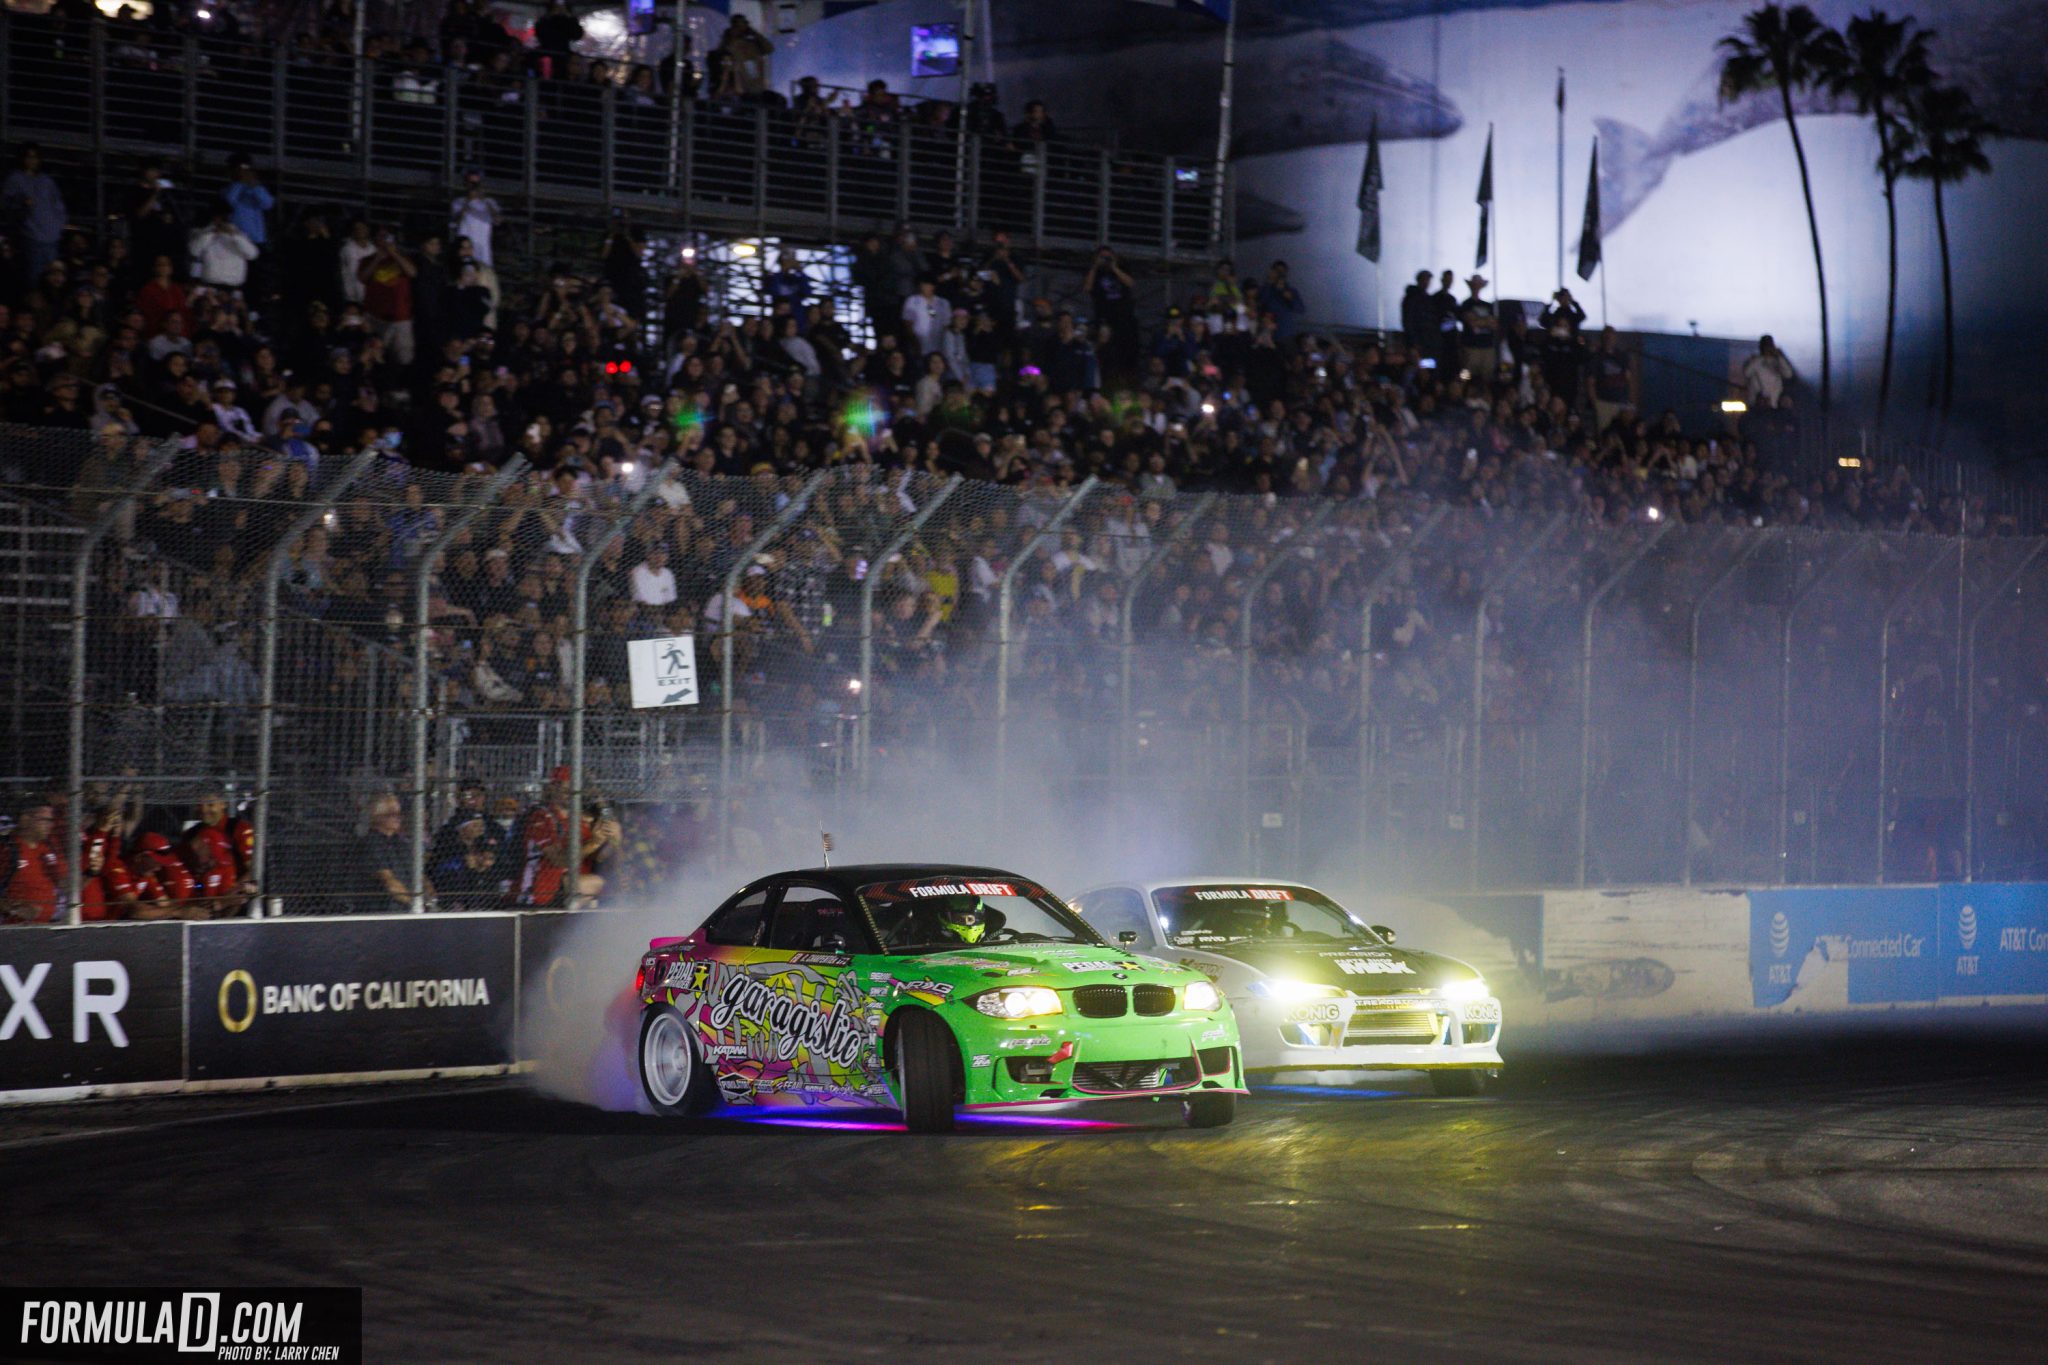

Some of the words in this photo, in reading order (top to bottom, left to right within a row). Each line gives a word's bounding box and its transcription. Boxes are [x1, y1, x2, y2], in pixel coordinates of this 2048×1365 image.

[658, 677, 692, 687] EXIT
[909, 884, 971, 898] FORMULA
[968, 883, 1015, 896] DRIFT
[1194, 890, 1251, 901] FORMULA
[1250, 889, 1291, 900] DRIFT
[1903, 933, 1926, 957] Car
[2000, 928, 2027, 952] AT&T
[1768, 964, 1792, 984] AT&T
[1956, 955, 1979, 976] AT&T
[263, 984, 326, 1014] BANC
[329, 982, 361, 1011] OF
[364, 978, 490, 1009] CALIFORNIA
[713, 1045, 747, 1059] KATANA
